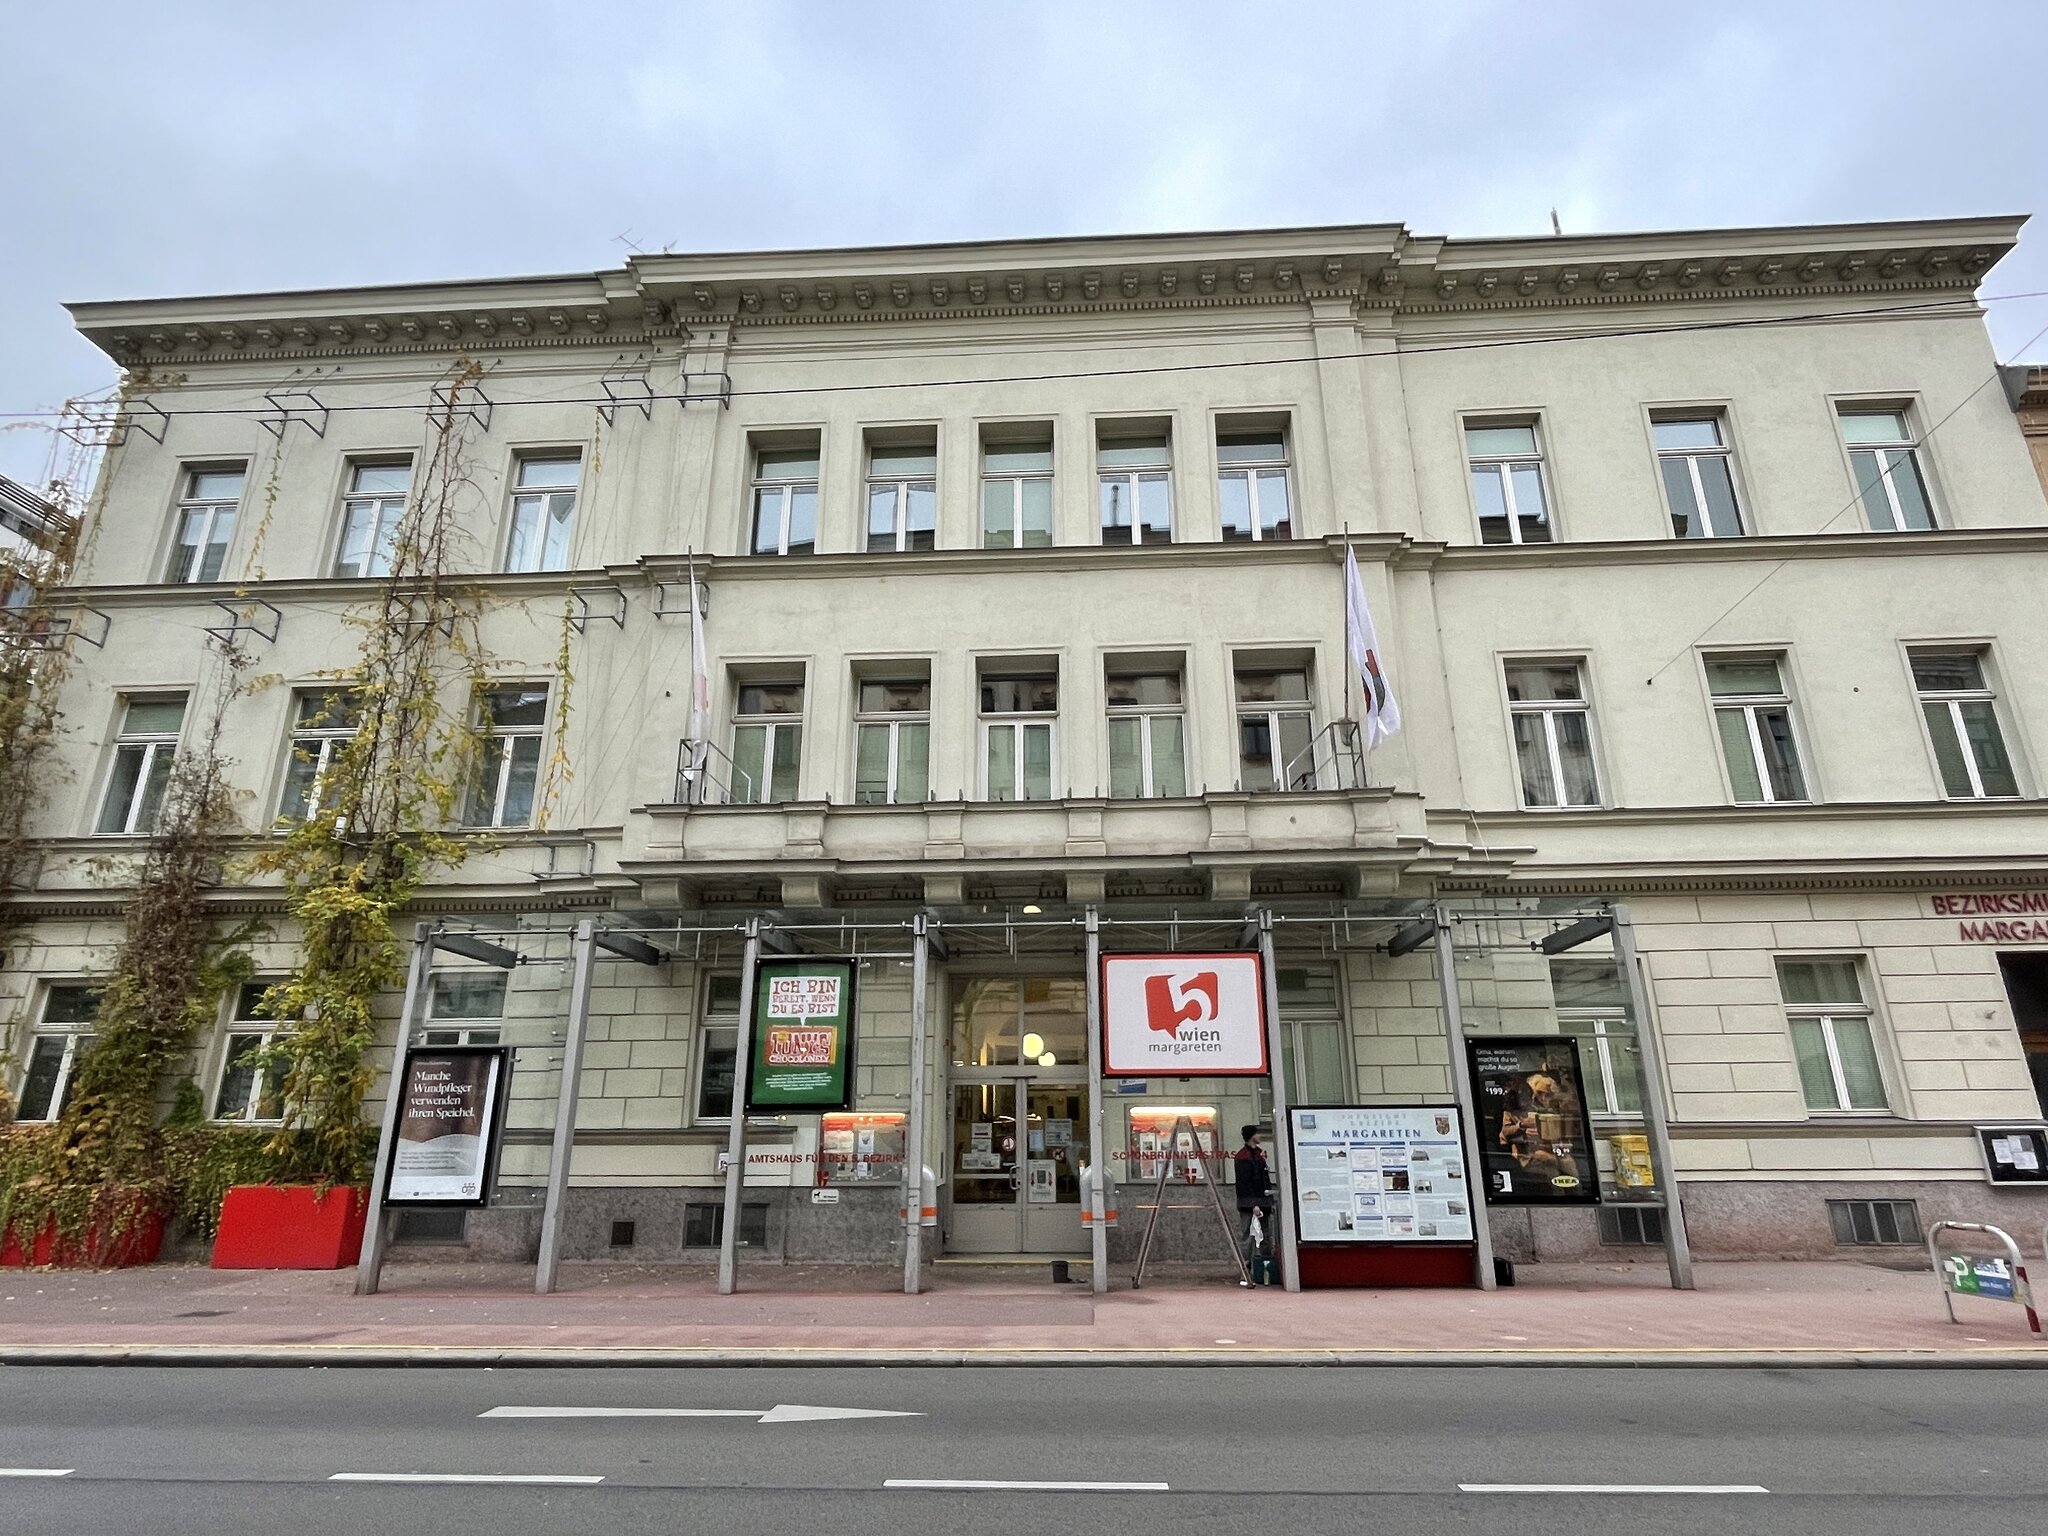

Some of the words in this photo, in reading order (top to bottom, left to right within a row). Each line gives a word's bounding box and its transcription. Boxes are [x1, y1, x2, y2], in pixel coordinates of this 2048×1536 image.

[1960, 919, 2048, 941] MARGA
[773, 980, 801, 994] ICH
[807, 979, 837, 994] BIN
[772, 1004, 787, 1014] DU
[791, 1004, 804, 1014] ES
[808, 1003, 836, 1014] BIST
[1178, 1027, 1220, 1042] wien
[1149, 1042, 1222, 1056] margareten
[414, 1071, 451, 1081] Manche
[414, 1082, 473, 1095] Wundpfleger
[410, 1095, 461, 1106] verwenden
[408, 1108, 434, 1118] ihren
[435, 1107, 475, 1119] Speichel.
[1331, 1129, 1422, 1138] MARGARETEN
[748, 1154, 803, 1164] AMTSHAUS
[828, 1154, 848, 1163] DEN
[863, 1154, 899, 1163] BEZIRK
